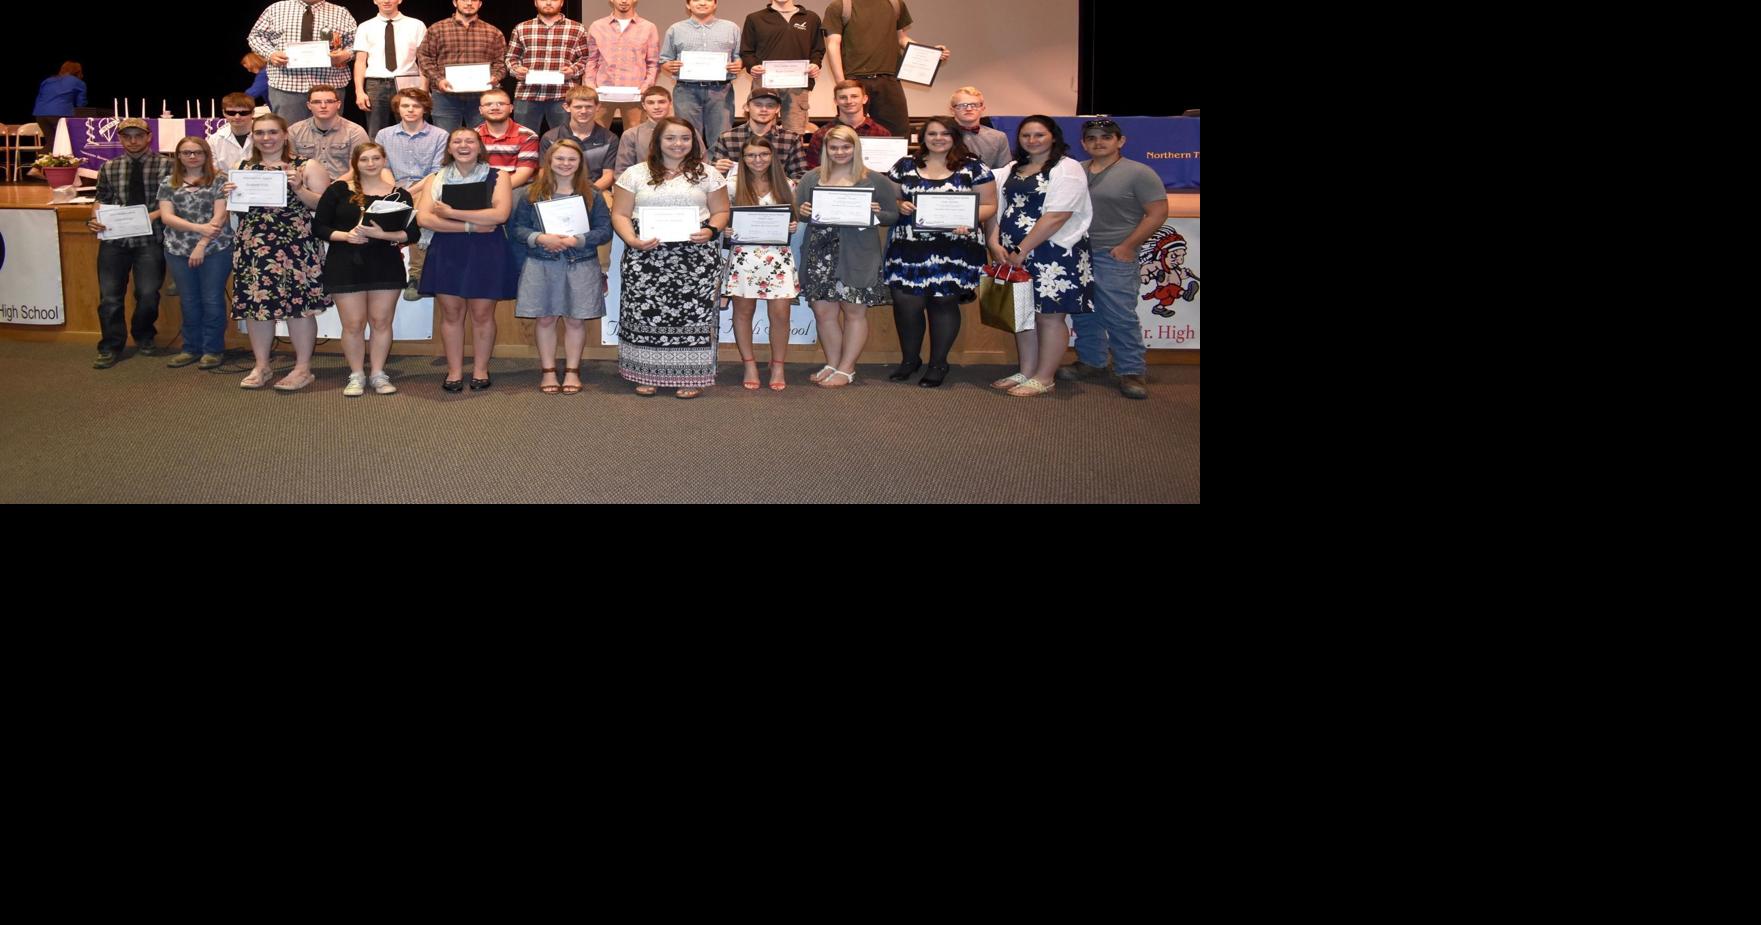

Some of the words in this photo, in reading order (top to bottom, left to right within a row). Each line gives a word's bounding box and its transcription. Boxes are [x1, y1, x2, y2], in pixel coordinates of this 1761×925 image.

[1146, 151, 1191, 160] Northern
[21, 305, 59, 320] School
[1158, 324, 1196, 344] High
